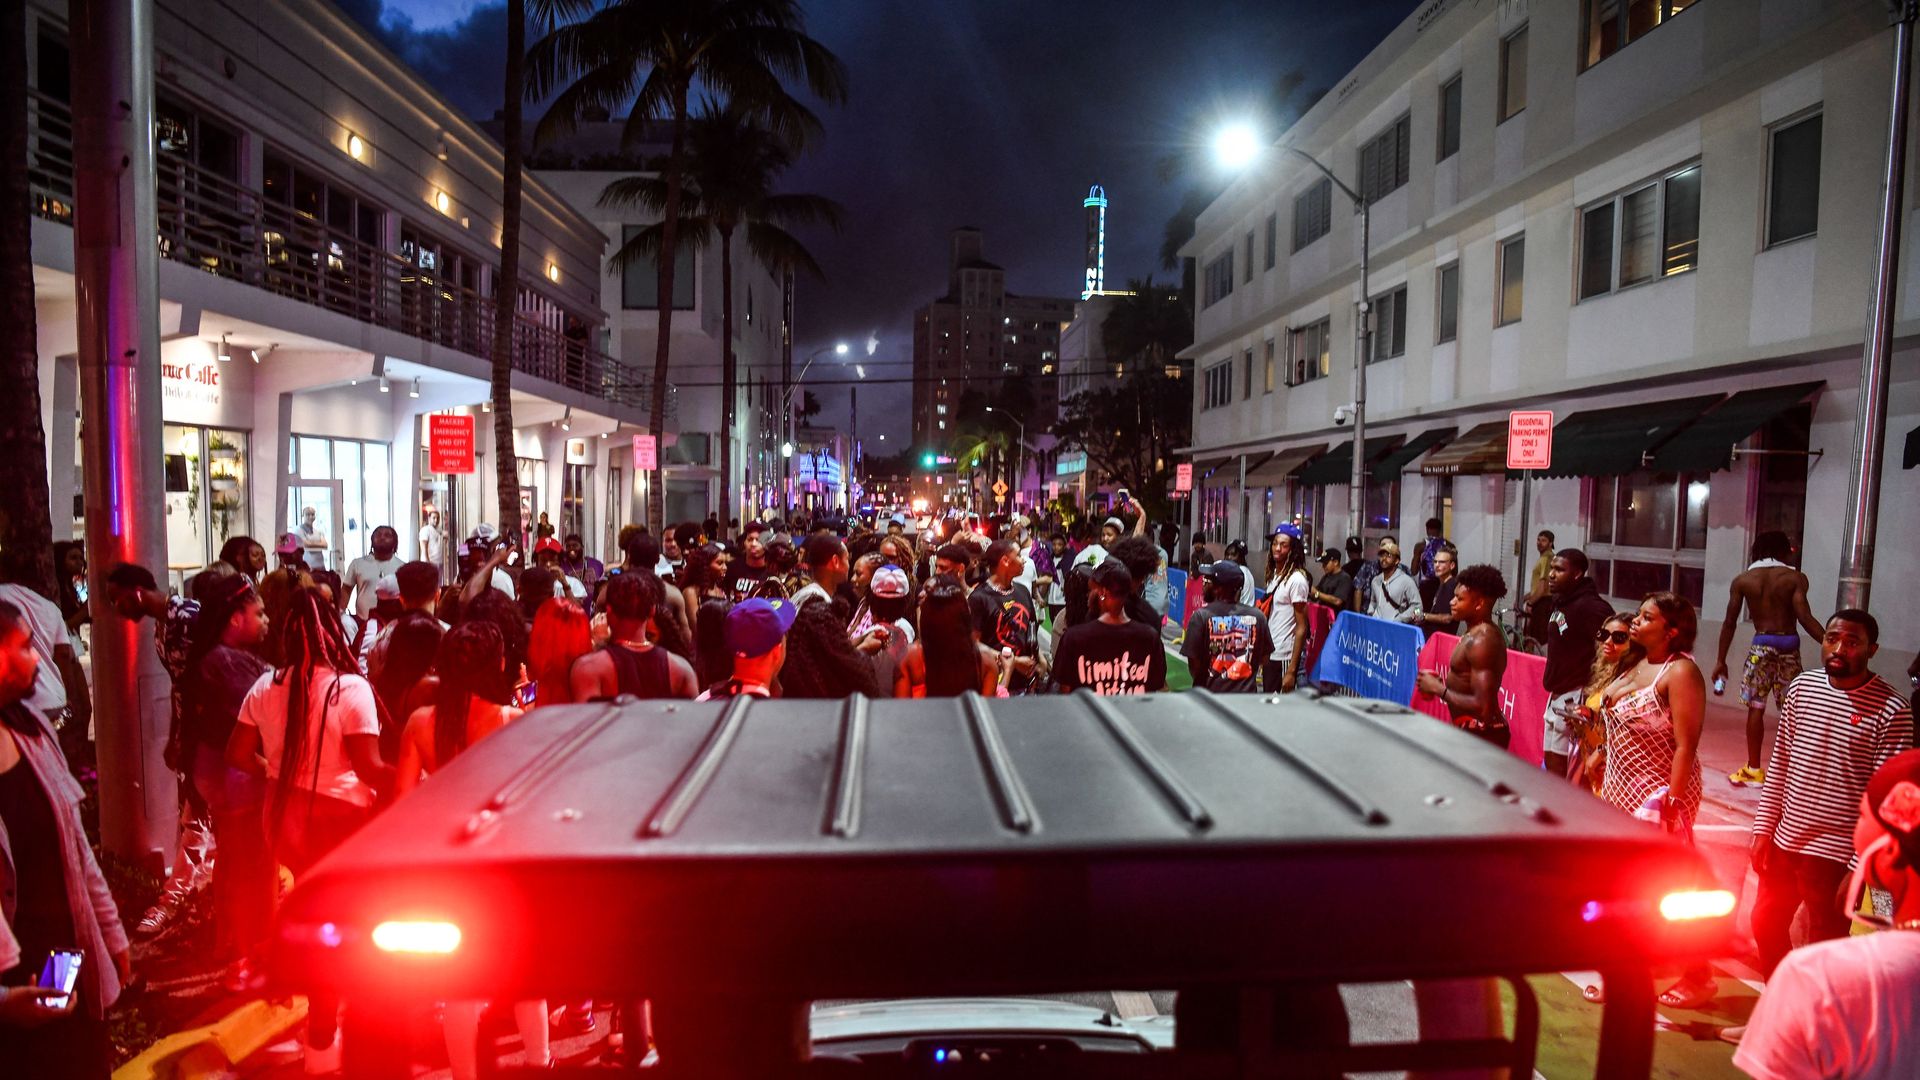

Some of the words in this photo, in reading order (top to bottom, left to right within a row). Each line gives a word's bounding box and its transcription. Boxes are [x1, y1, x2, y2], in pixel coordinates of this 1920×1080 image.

[1517, 418, 1544, 426] RESIDENTIAL
[433, 428, 470, 436] EMERGENCY
[1512, 429, 1532, 437] PARKING
[1521, 439, 1534, 447] ZONE
[438, 449, 466, 457] VEHICLES
[1077, 650, 1151, 685] limited
